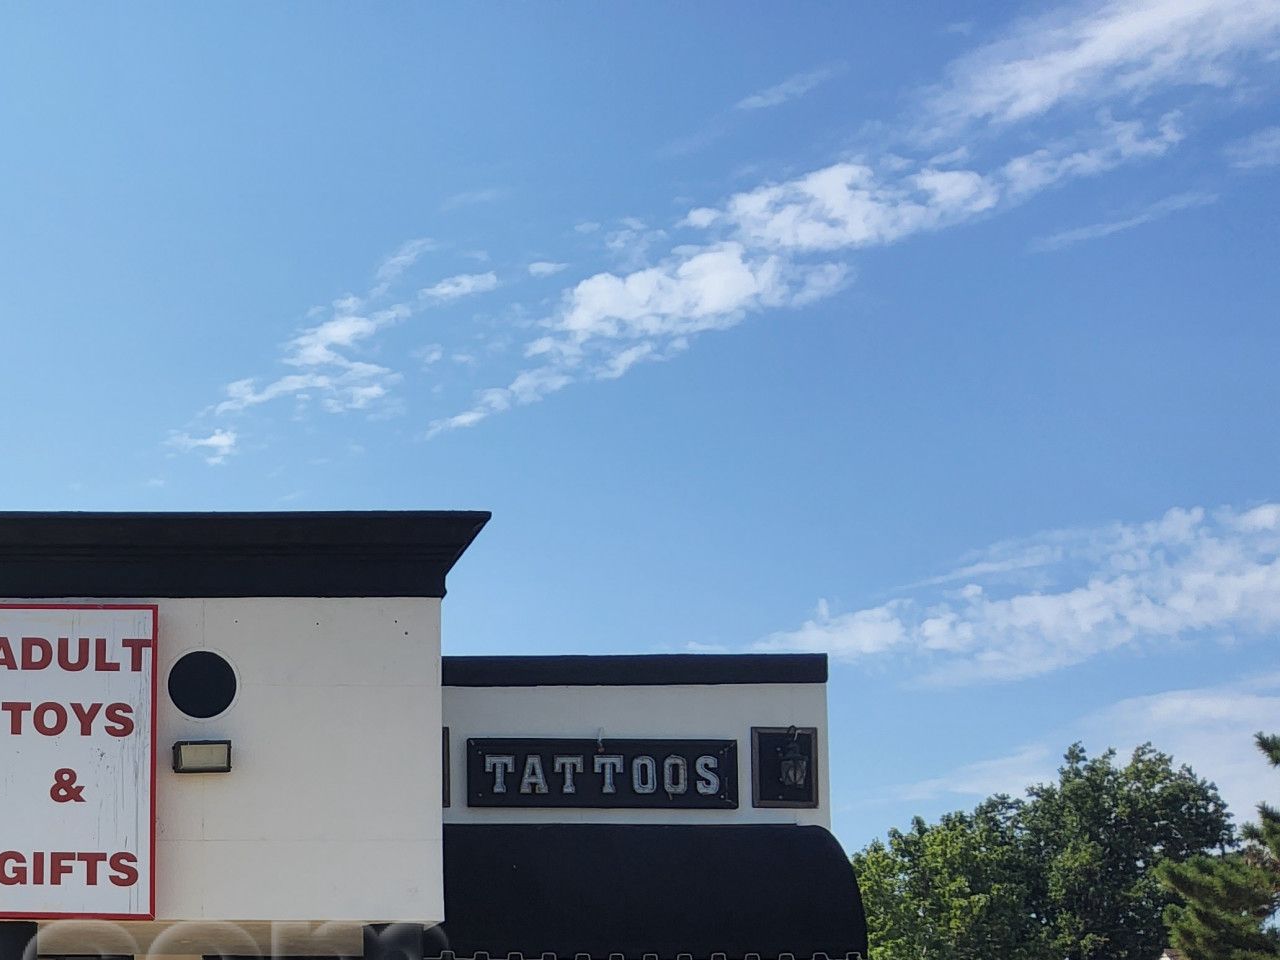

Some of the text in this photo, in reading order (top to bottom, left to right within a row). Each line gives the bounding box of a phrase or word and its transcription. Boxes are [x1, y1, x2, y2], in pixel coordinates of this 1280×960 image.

[1, 701, 135, 738] TOYS
[49, 767, 87, 803] &
[484, 753, 721, 796] TATTOOS
